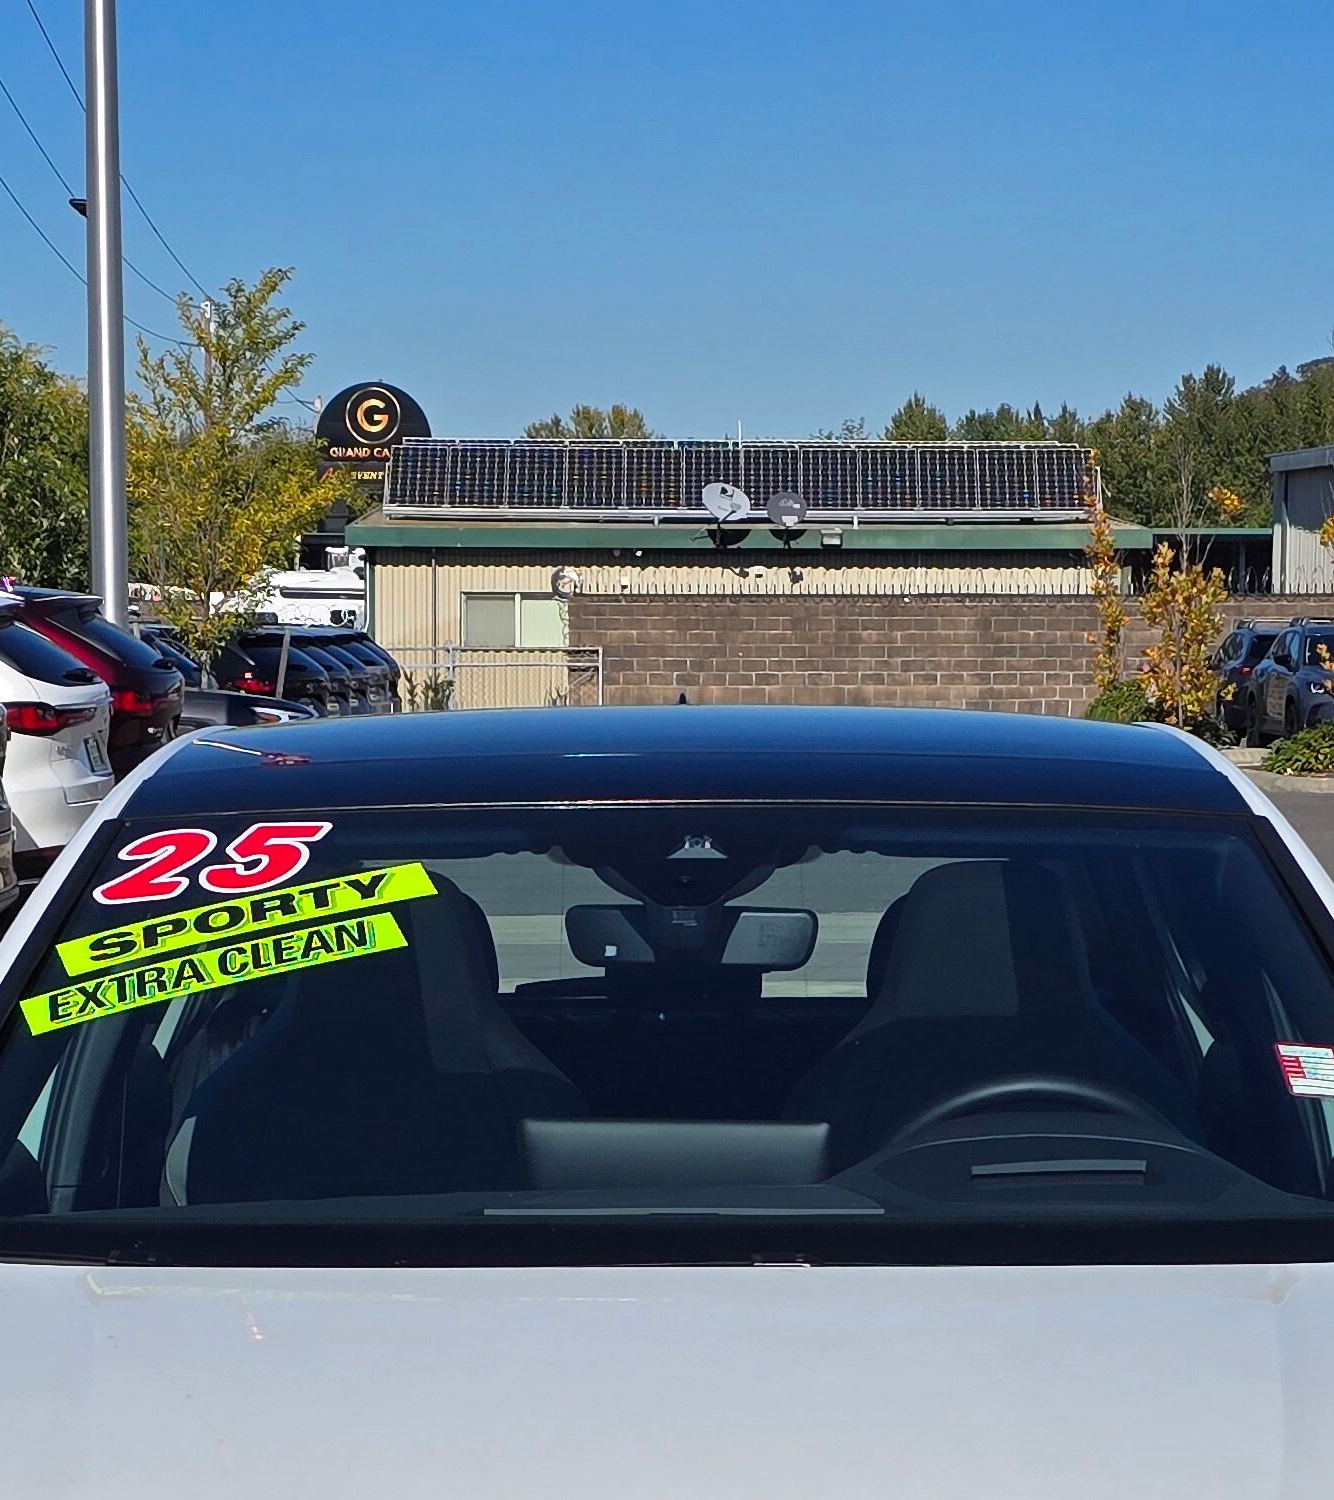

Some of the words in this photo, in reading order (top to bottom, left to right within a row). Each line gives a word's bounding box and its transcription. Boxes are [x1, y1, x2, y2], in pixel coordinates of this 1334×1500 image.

[357, 399, 389, 432] G
[93, 822, 333, 904] 25
[89, 872, 395, 962] SPORTY
[48, 959, 215, 1024] EXTRA
[218, 919, 377, 977] CLEAN
